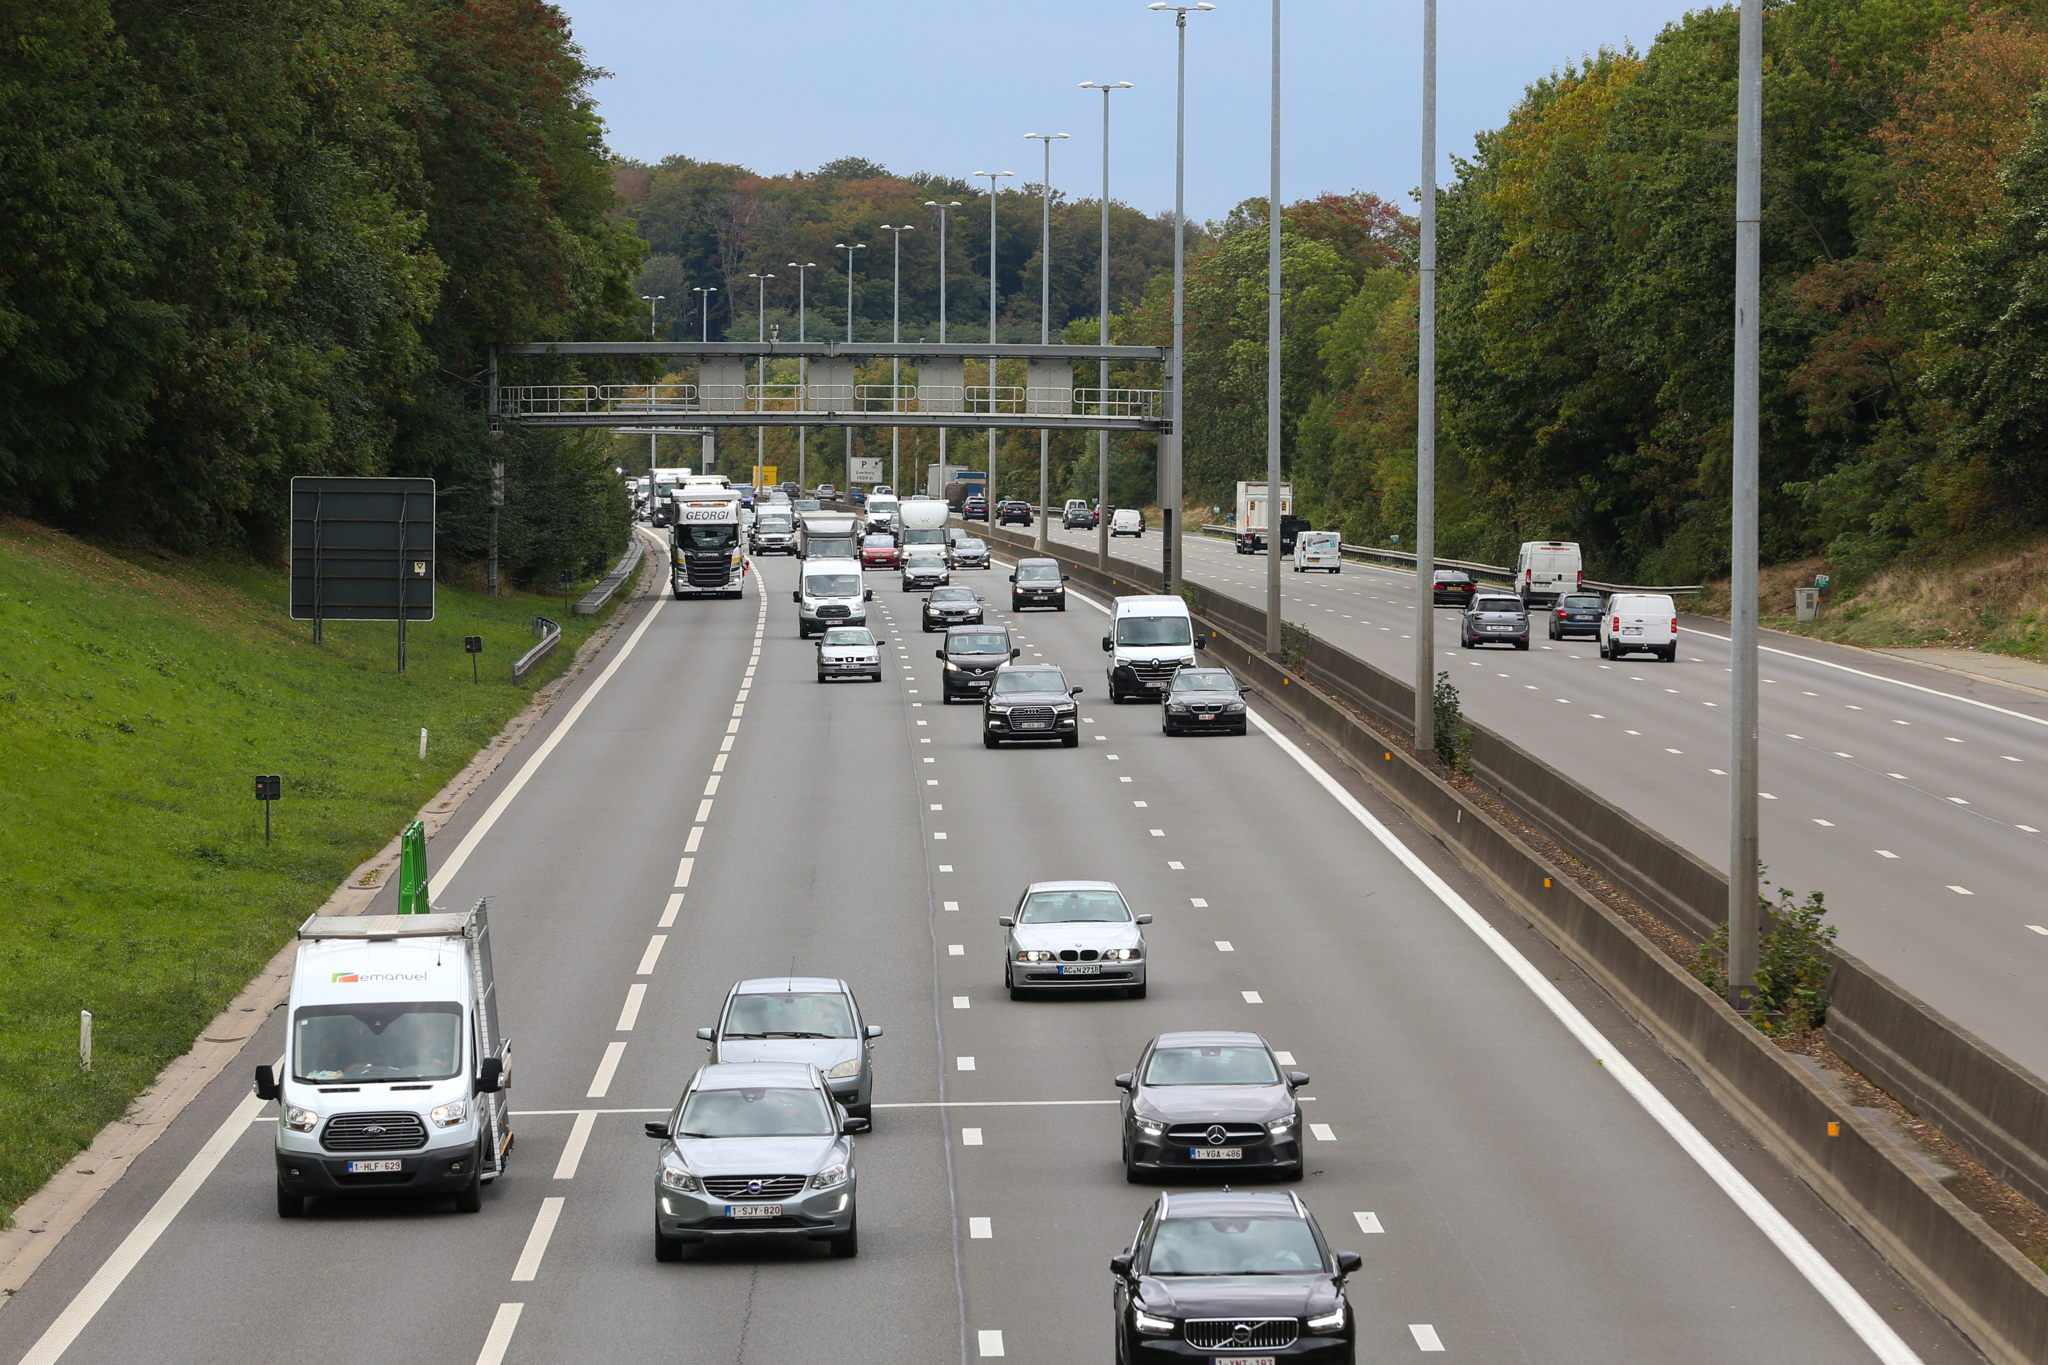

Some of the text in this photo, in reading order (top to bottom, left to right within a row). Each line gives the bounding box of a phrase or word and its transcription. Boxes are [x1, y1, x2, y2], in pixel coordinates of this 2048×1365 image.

[686, 511, 729, 520] GEORGI
[360, 972, 427, 981] emanuel
[1197, 1150, 1241, 1158] 1-VGA-486
[354, 1161, 400, 1171] 1-HLF-629
[732, 1206, 780, 1215] 1-SJY-820
